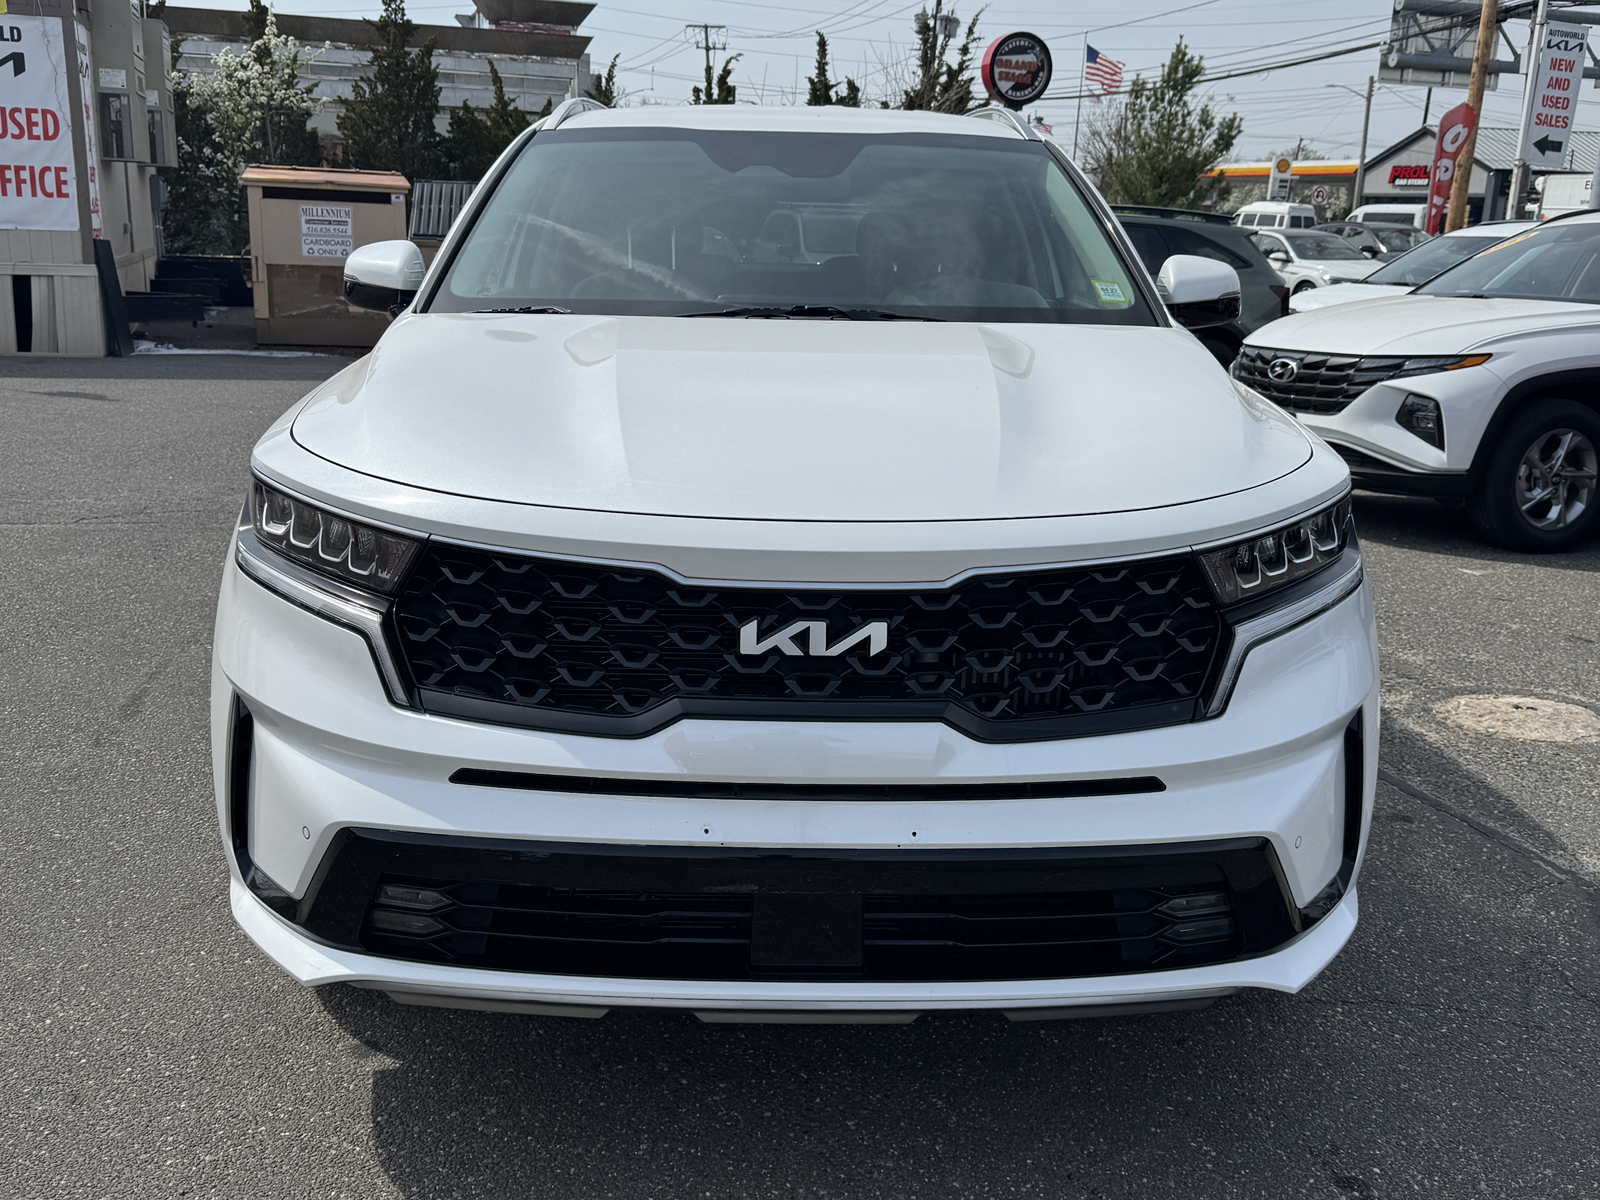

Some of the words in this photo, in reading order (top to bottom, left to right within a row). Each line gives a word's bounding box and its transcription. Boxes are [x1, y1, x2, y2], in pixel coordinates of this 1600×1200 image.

[1549, 29, 1585, 40] AUTOWORLD
[1547, 39, 1584, 52] KIA
[996, 58, 1037, 72] GRAND
[1549, 57, 1576, 73] NEW
[998, 71, 1032, 84] STAGE
[1547, 76, 1571, 91] AND
[1541, 94, 1570, 110] USED
[1535, 112, 1569, 129] SALES
[1389, 167, 1432, 183] PROL
[301, 207, 350, 219] MILLENNIUM
[303, 238, 351, 247] CARDBOARD
[317, 248, 338, 256] ONLY
[740, 620, 888, 657] KIA
